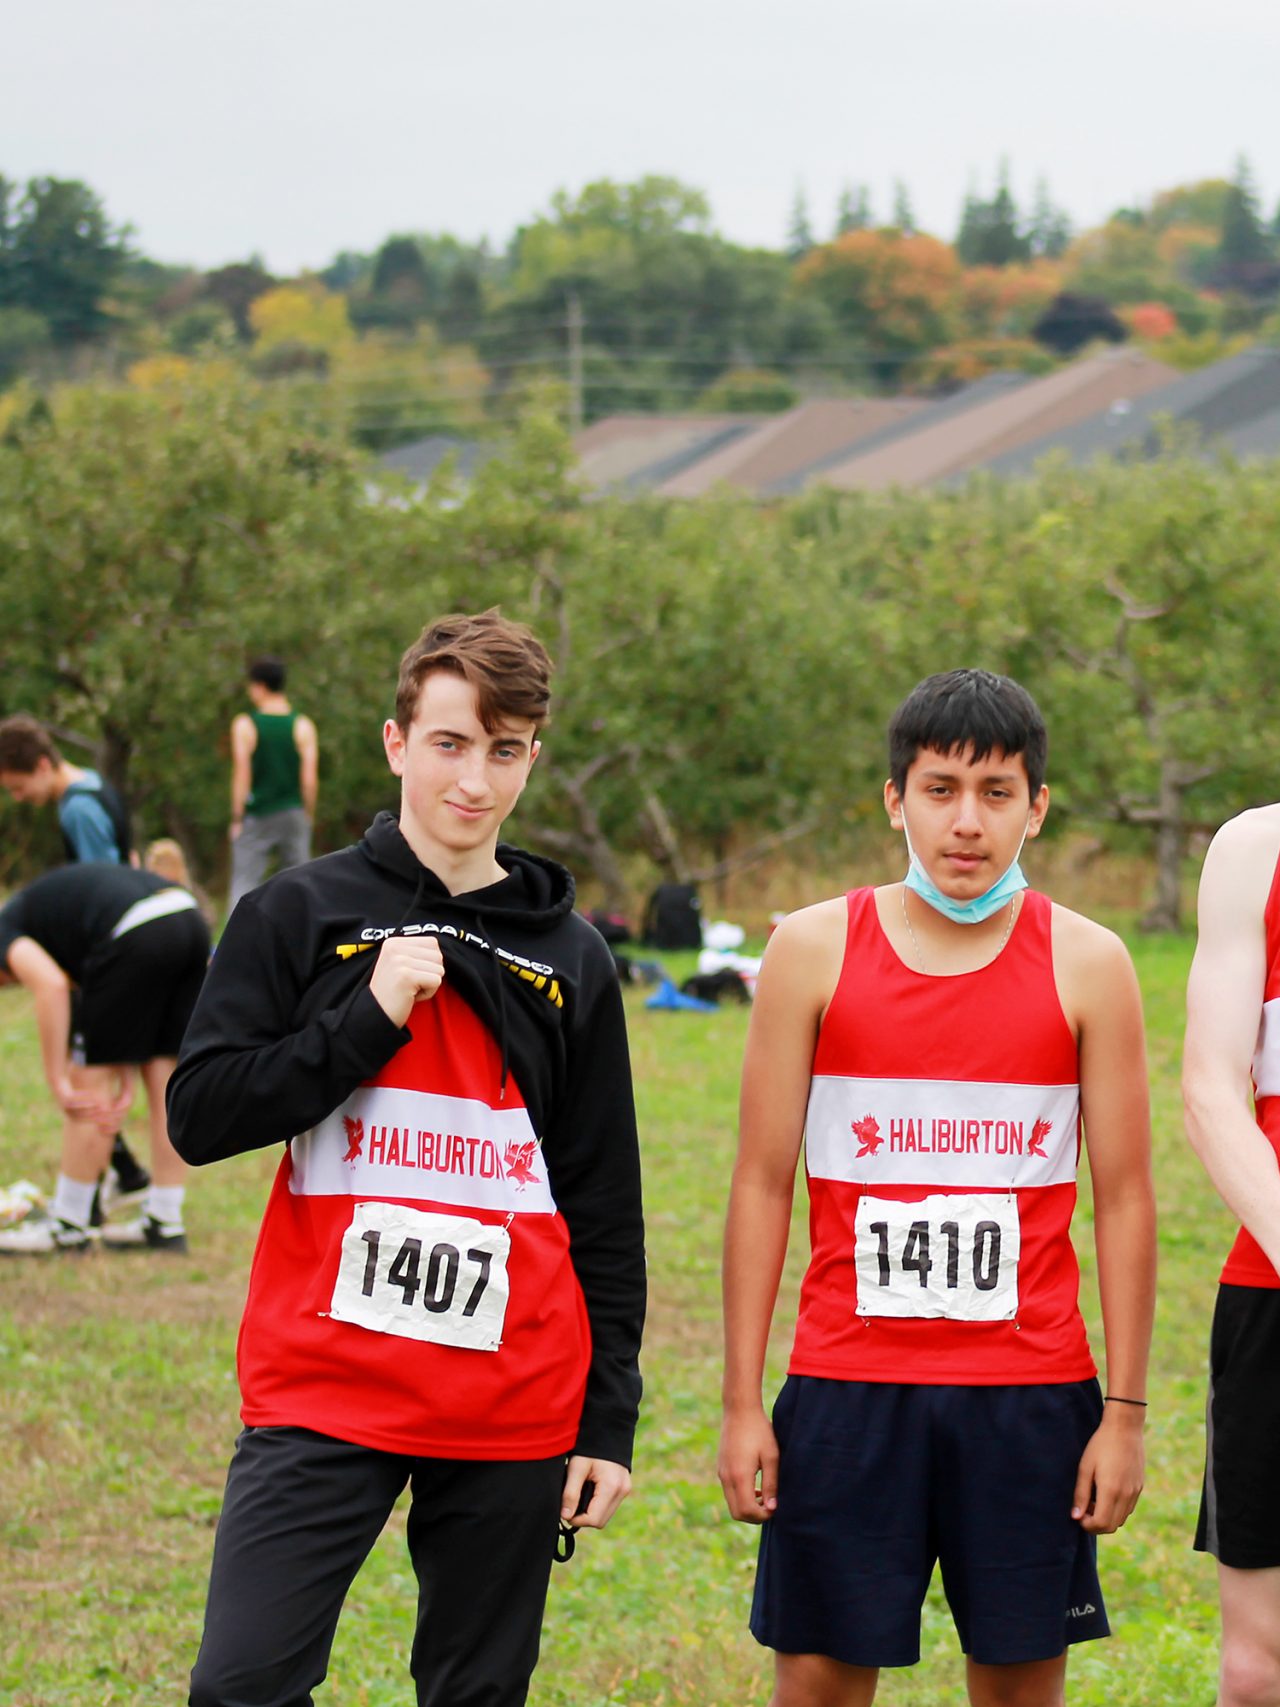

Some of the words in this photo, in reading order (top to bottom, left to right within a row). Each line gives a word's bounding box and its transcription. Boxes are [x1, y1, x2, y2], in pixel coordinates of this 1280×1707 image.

[369, 1125, 505, 1181] HALIBURTON
[889, 1118, 1024, 1155] HALIBURTON
[360, 1229, 493, 1318] 1407
[869, 1220, 1001, 1291] 1410
[1065, 1603, 1096, 1618] ILA
